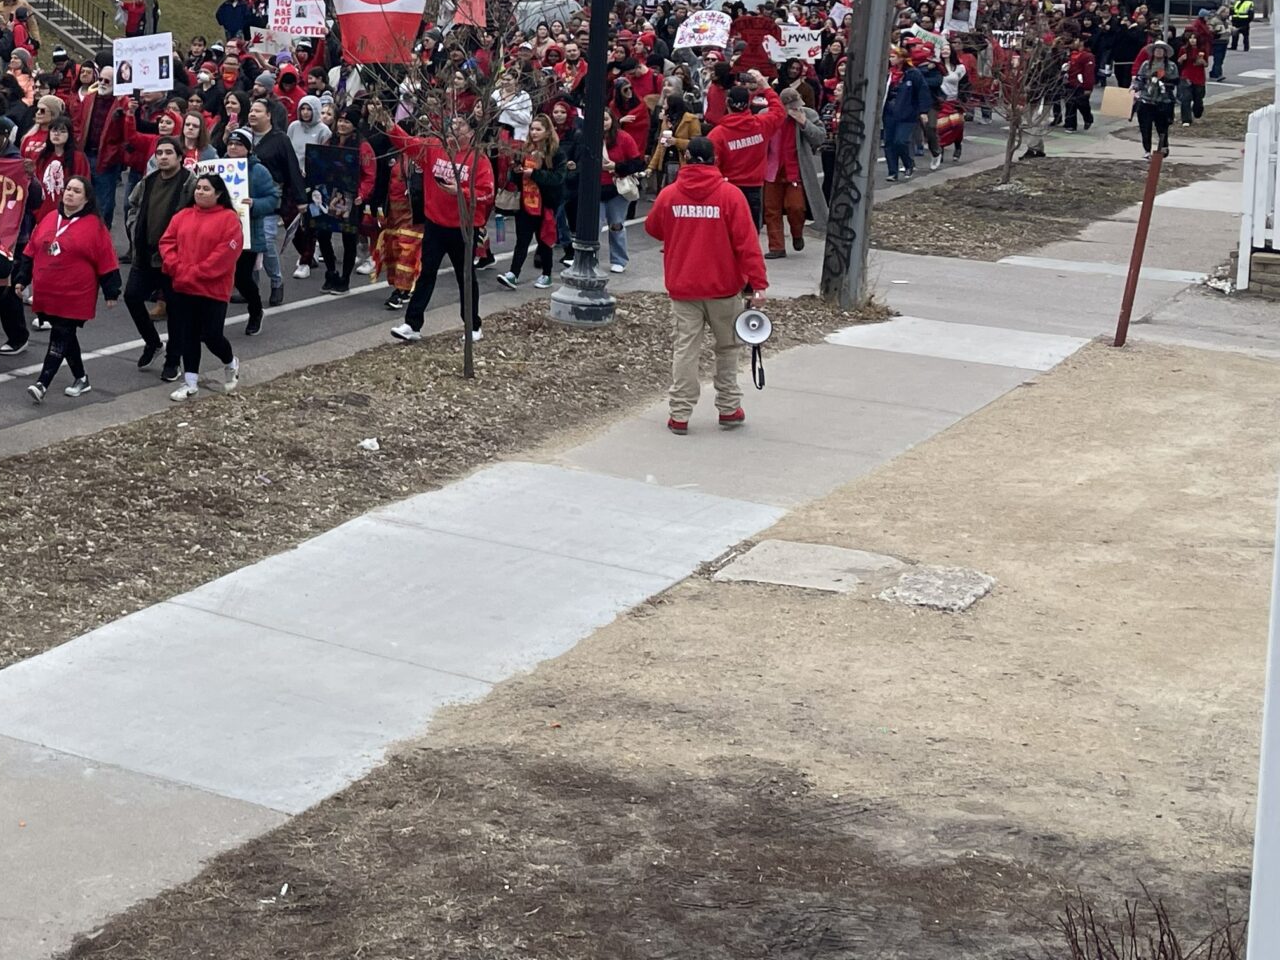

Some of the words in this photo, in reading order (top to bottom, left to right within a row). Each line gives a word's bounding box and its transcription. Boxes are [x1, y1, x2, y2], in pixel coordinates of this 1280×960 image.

[274, 8, 292, 17] ARE
[274, 17, 292, 25] NOT
[672, 205, 720, 219] WARRIOR
